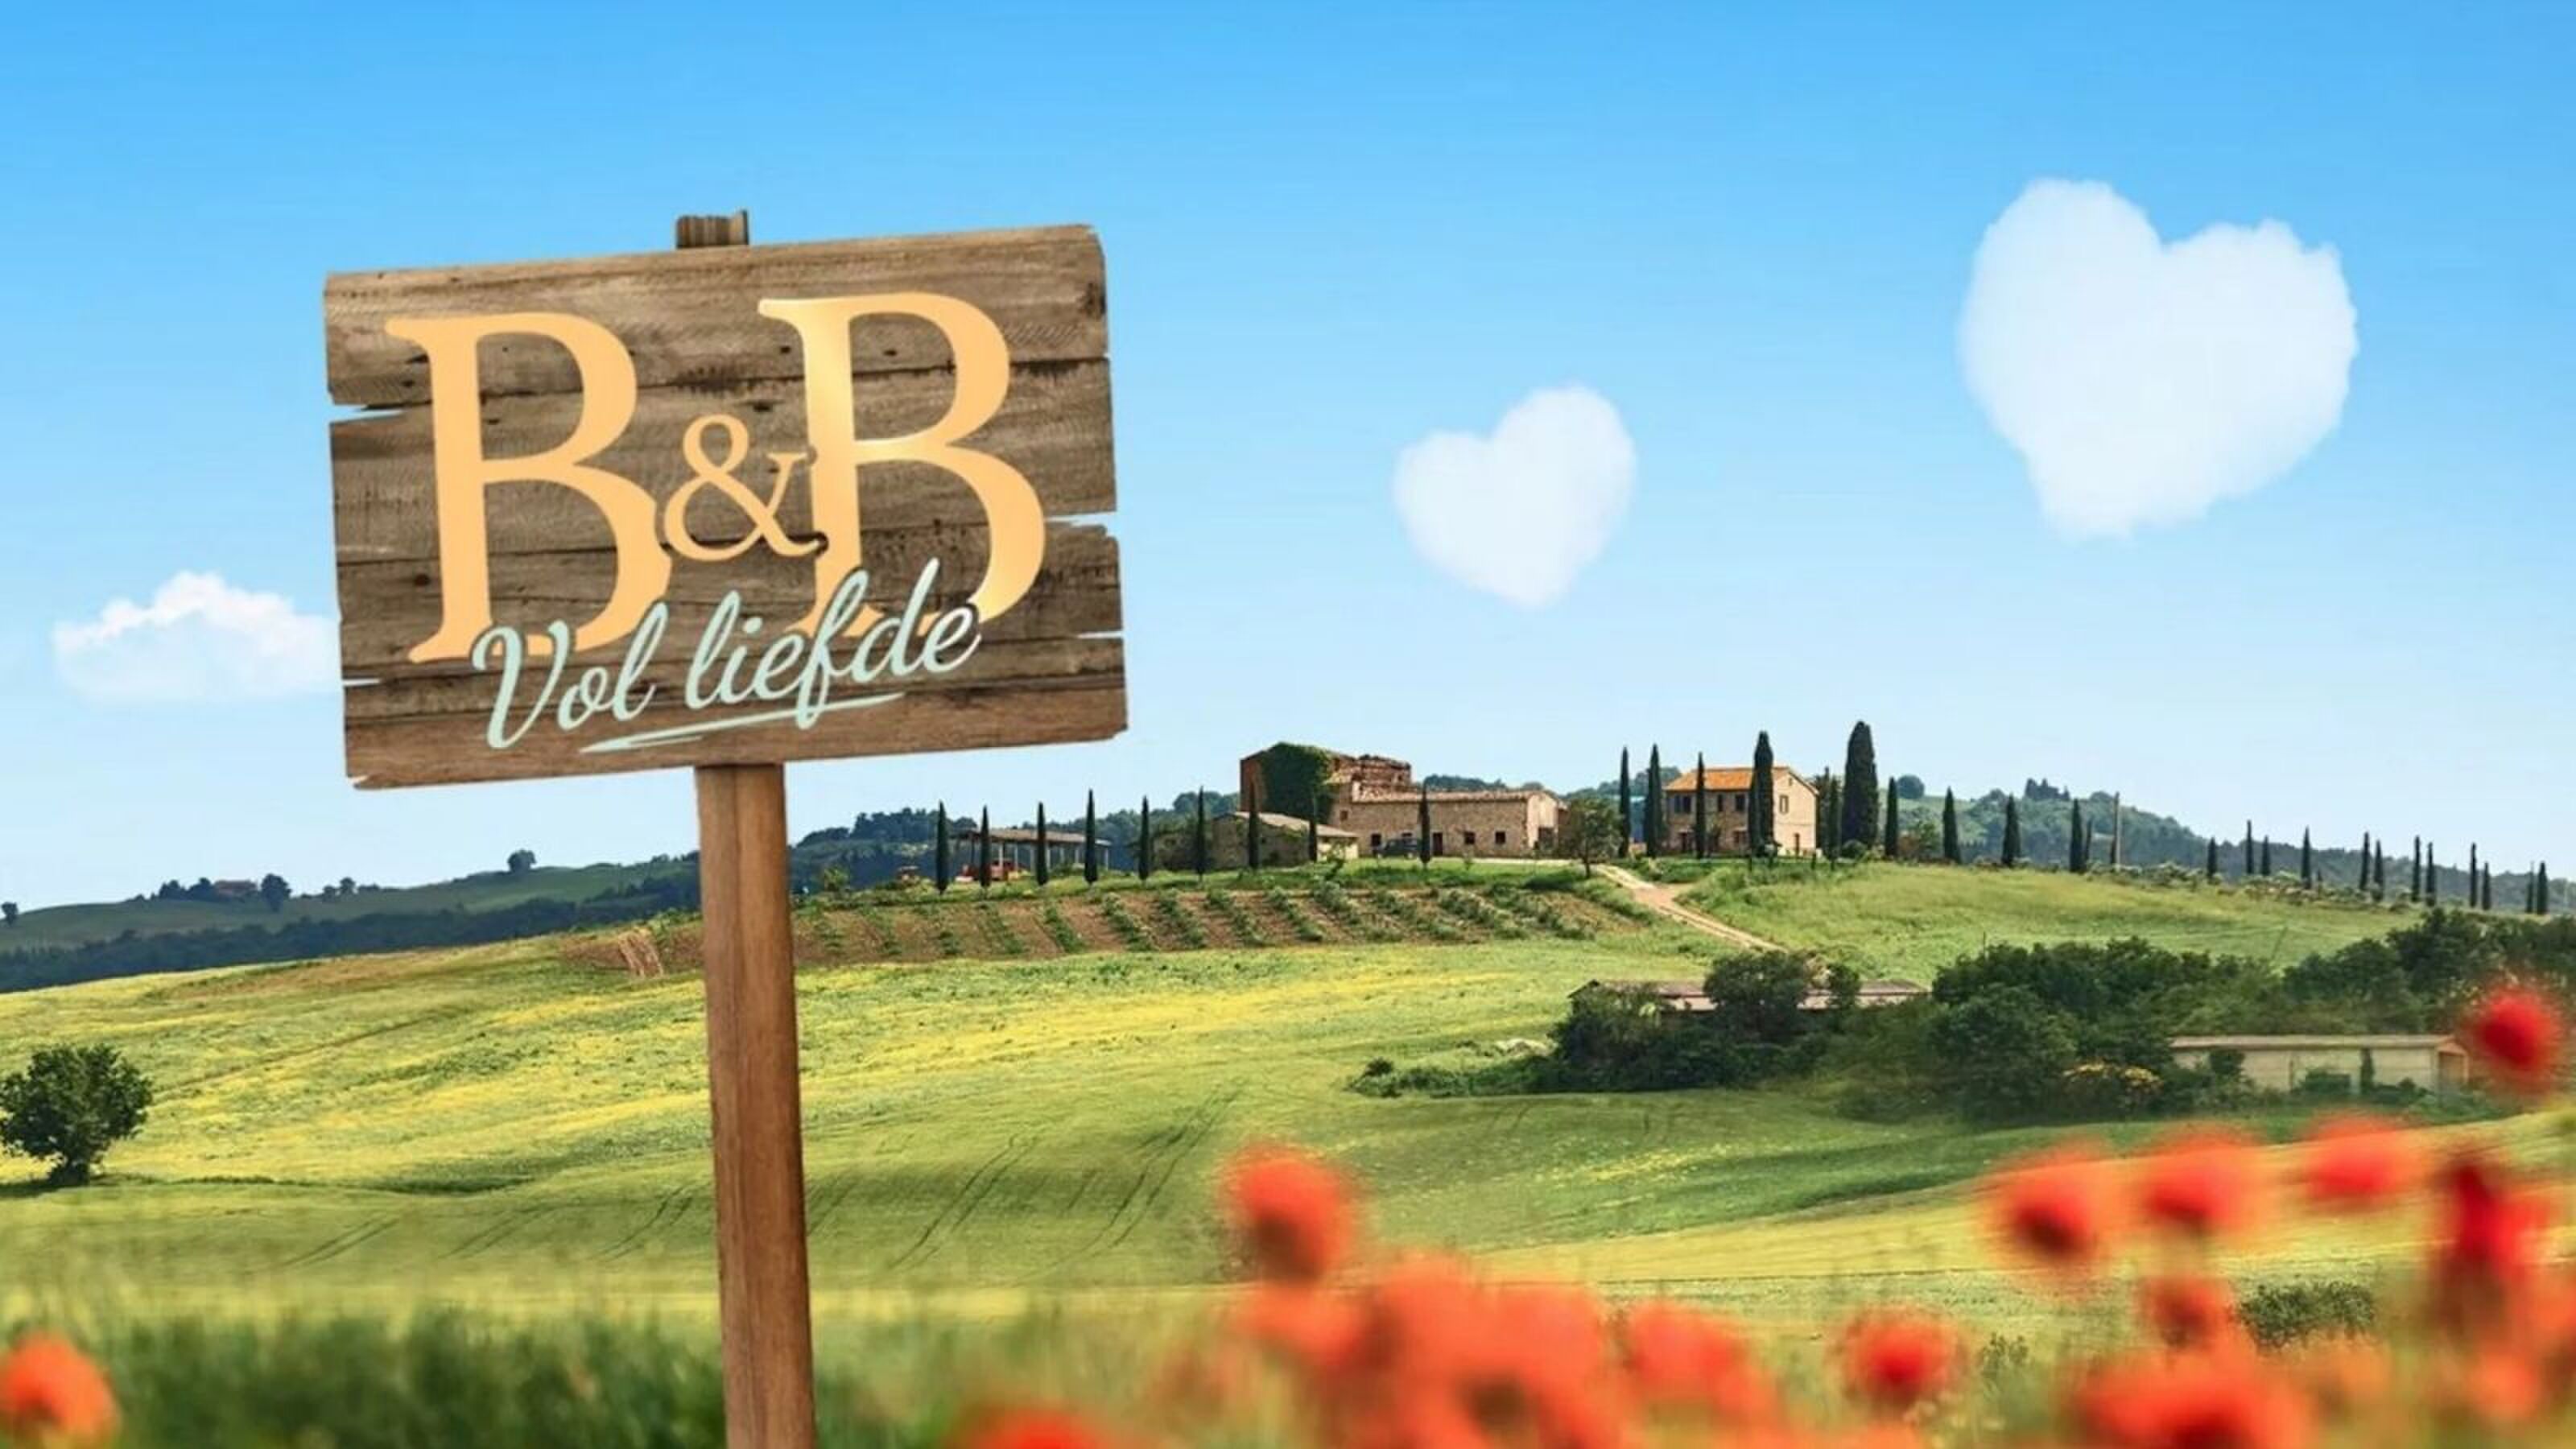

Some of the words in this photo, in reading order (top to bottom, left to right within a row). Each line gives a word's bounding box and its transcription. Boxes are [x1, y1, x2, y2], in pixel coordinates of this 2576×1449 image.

[385, 291, 1046, 663] B&B
[472, 601, 669, 750] Vol
[684, 556, 982, 729] liefde
